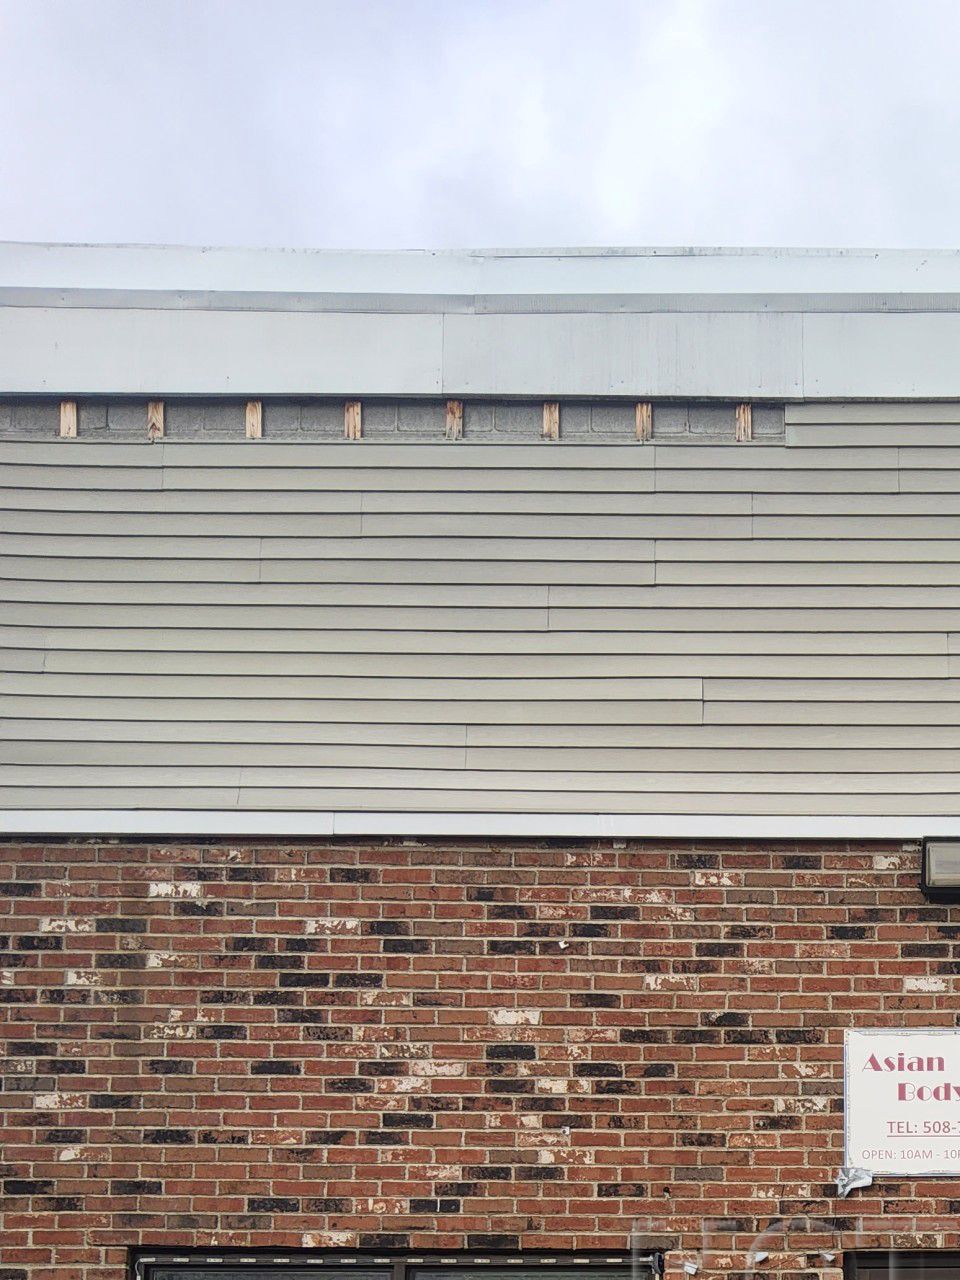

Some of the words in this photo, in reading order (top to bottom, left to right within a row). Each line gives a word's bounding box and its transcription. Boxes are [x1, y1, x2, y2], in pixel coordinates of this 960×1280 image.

[862, 1053, 945, 1072] Asian
[887, 1121, 918, 1134] TEL:
[861, 1150, 897, 1160] OPEN:
[901, 1150, 933, 1160] 10AM
